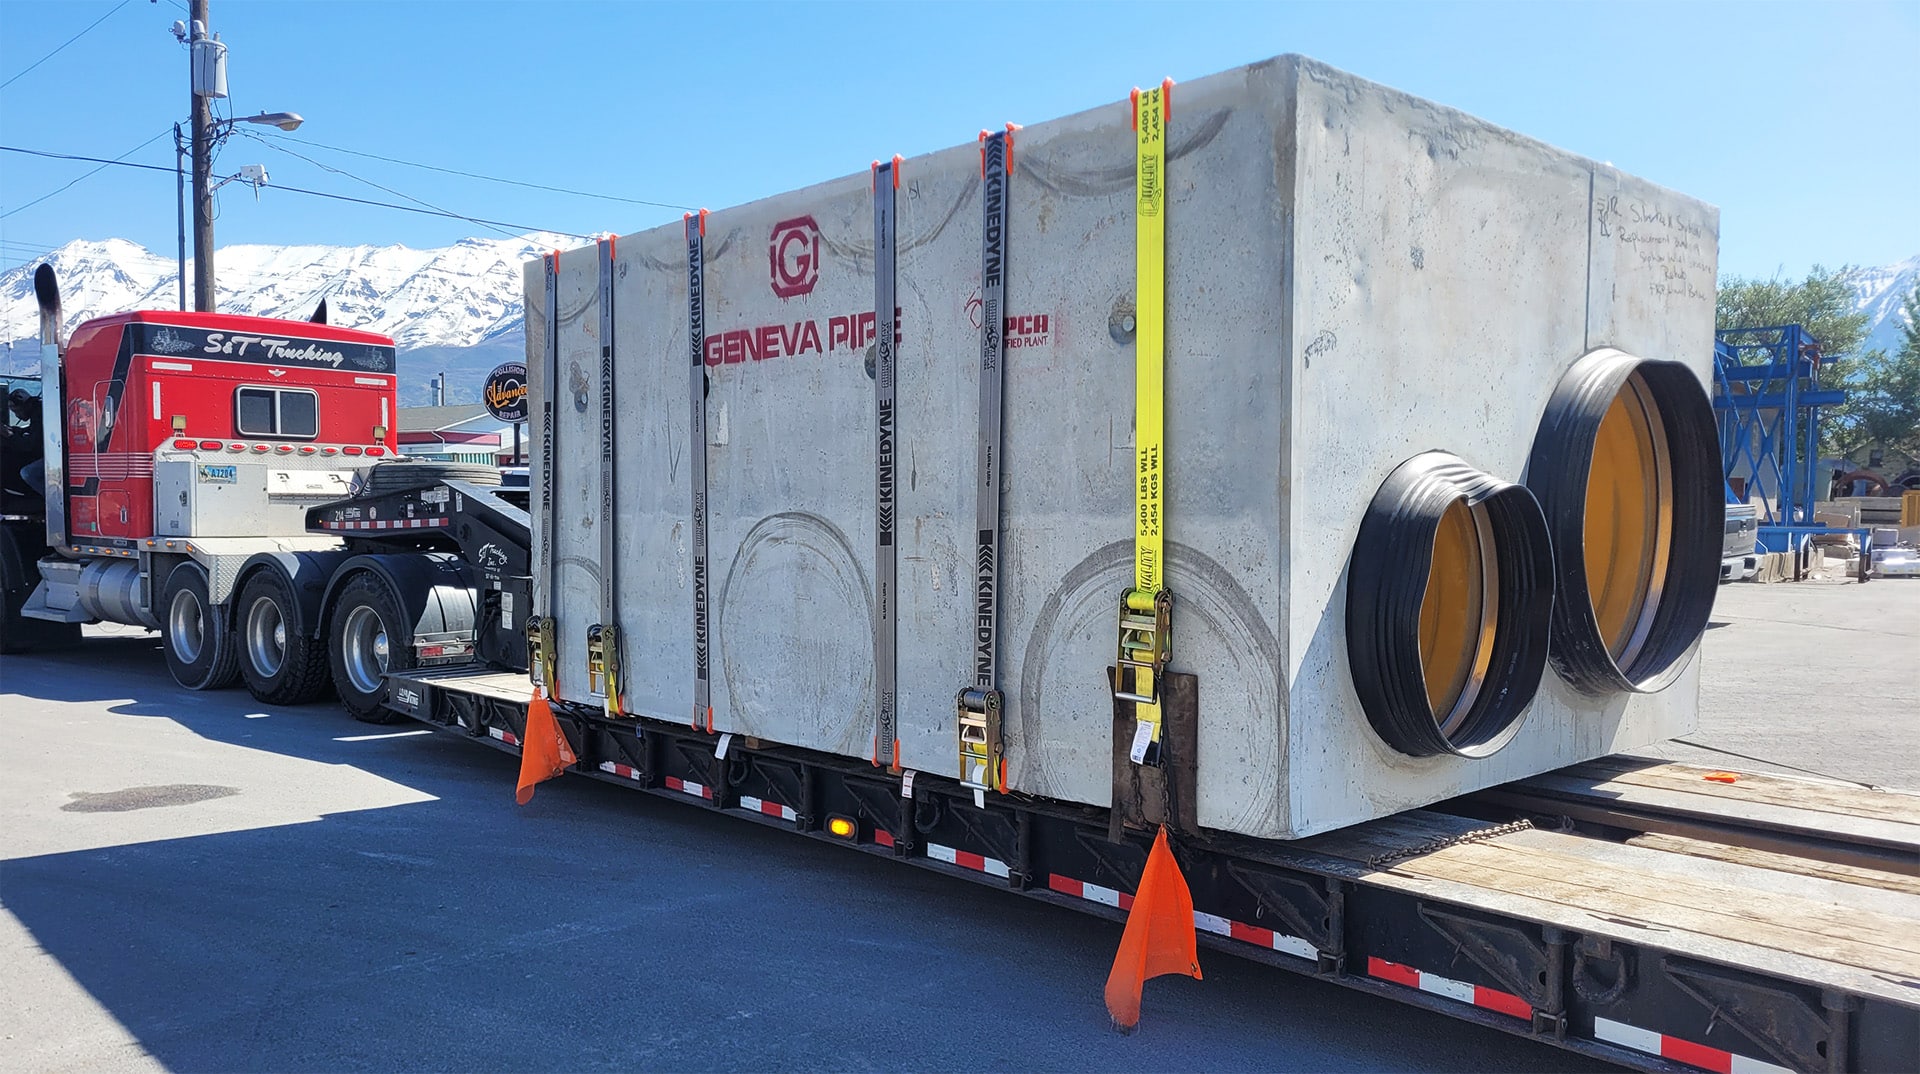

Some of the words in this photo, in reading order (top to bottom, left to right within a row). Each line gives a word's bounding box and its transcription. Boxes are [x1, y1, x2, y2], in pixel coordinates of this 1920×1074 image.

[1141, 111, 1149, 144] 5,400
[1152, 107, 1160, 142] 2,454
[985, 171, 1002, 289] KINEDYNE
[689, 238, 702, 330] KINEDYNE
[1004, 315, 1049, 336] PCA
[1004, 337, 1023, 349] IFIED
[1024, 335, 1048, 348] PLANT
[204, 333, 262, 356] S&T
[260, 338, 345, 368] Trucking
[704, 319, 823, 368] GENEVA
[498, 410, 521, 419] REPAIR
[602, 380, 611, 464] KINEDYNE
[879, 398, 893, 504] KINEDYNE
[1140, 447, 1148, 473] WLL
[542, 433, 552, 511] KINEDYNE
[1140, 477, 1148, 500] LBS
[335, 510, 344, 522] 214
[1140, 504, 1148, 536] 5,400
[1151, 503, 1159, 536] 2,454
[695, 555, 707, 643] KINEDYNE
[977, 576, 994, 687] KINEDYNE
